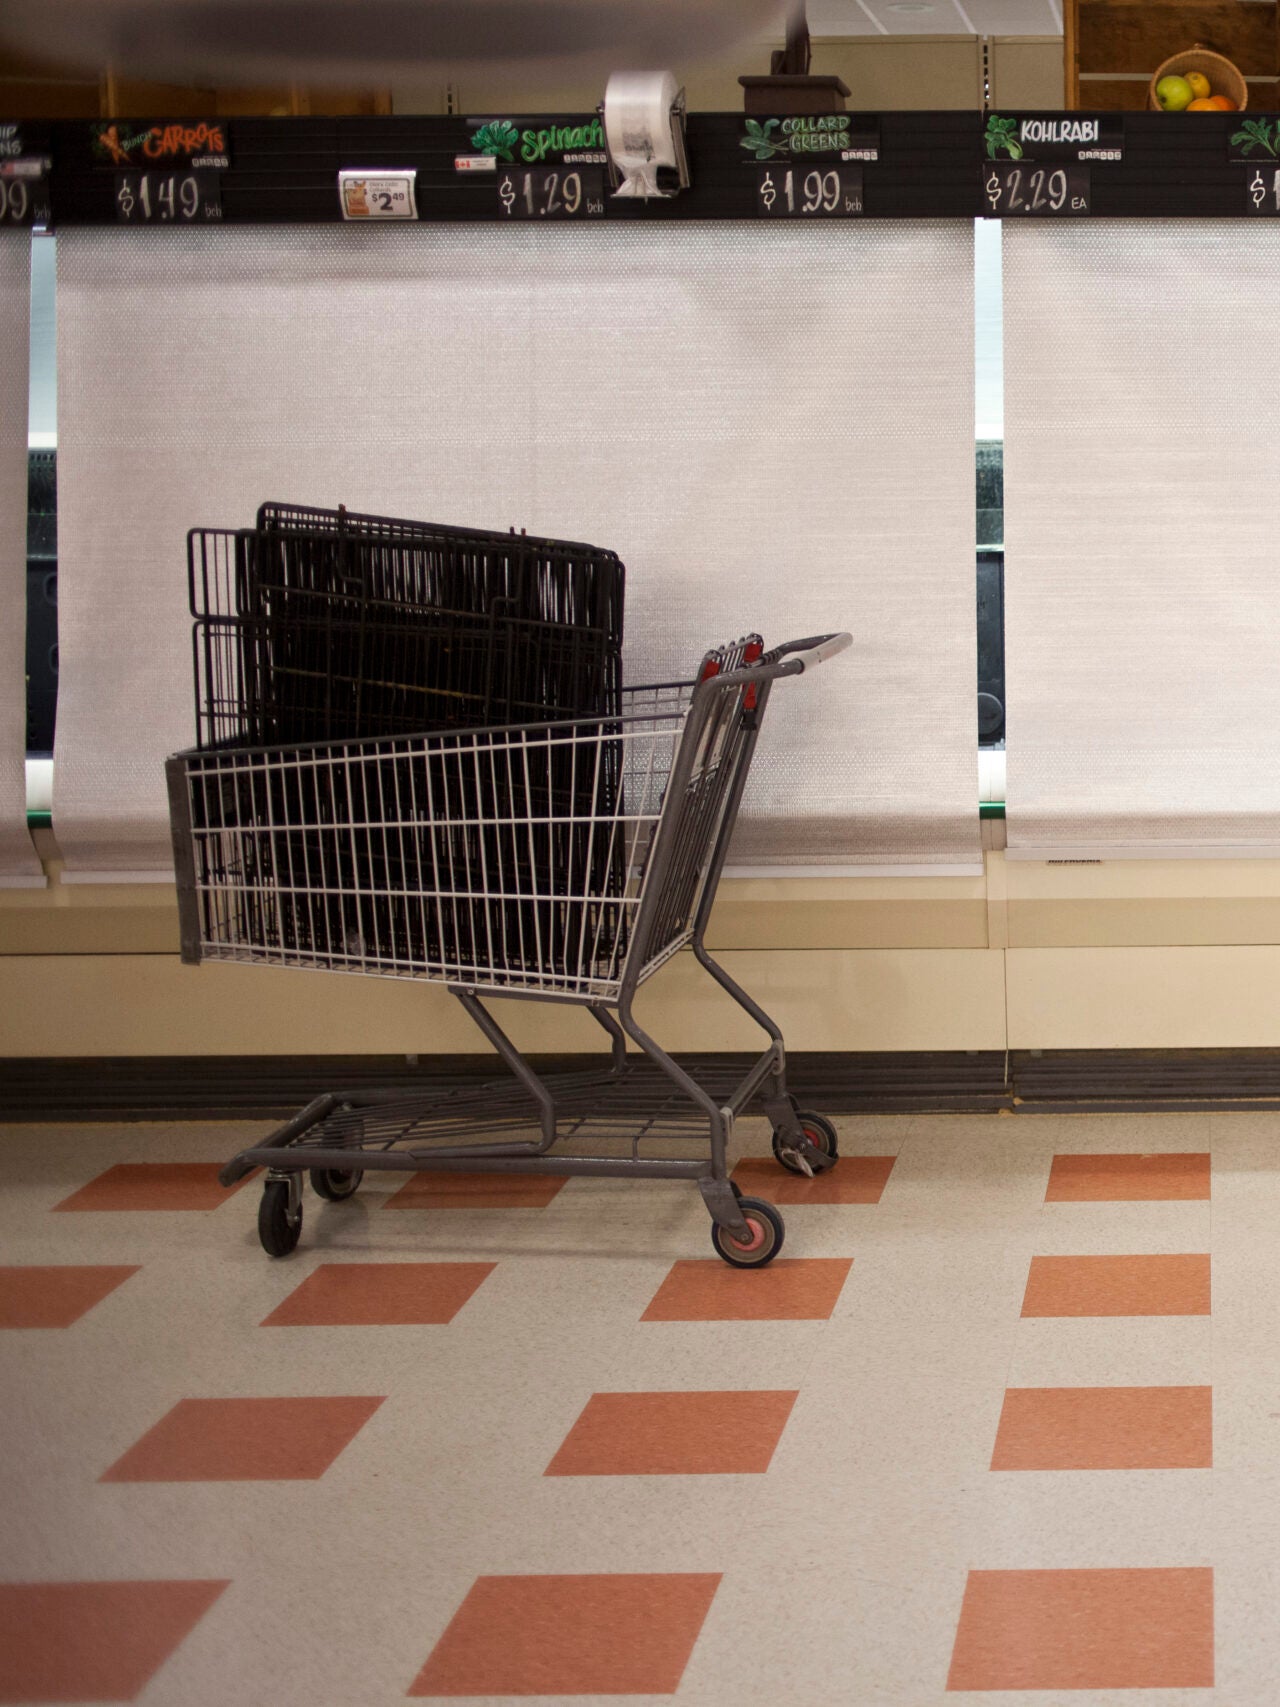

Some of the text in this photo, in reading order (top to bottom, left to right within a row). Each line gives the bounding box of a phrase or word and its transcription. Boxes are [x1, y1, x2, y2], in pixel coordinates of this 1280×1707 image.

[143, 121, 224, 158] CARROTS
[781, 116, 851, 134] COLLARD
[1020, 120, 1099, 143] KOHLRABI
[788, 132, 851, 152] GREENS
[499, 172, 604, 215] $1.29 bch
[760, 170, 862, 213] $1.99 bch
[986, 169, 1088, 212] $2.29 EA
[204, 202, 223, 217] bch
